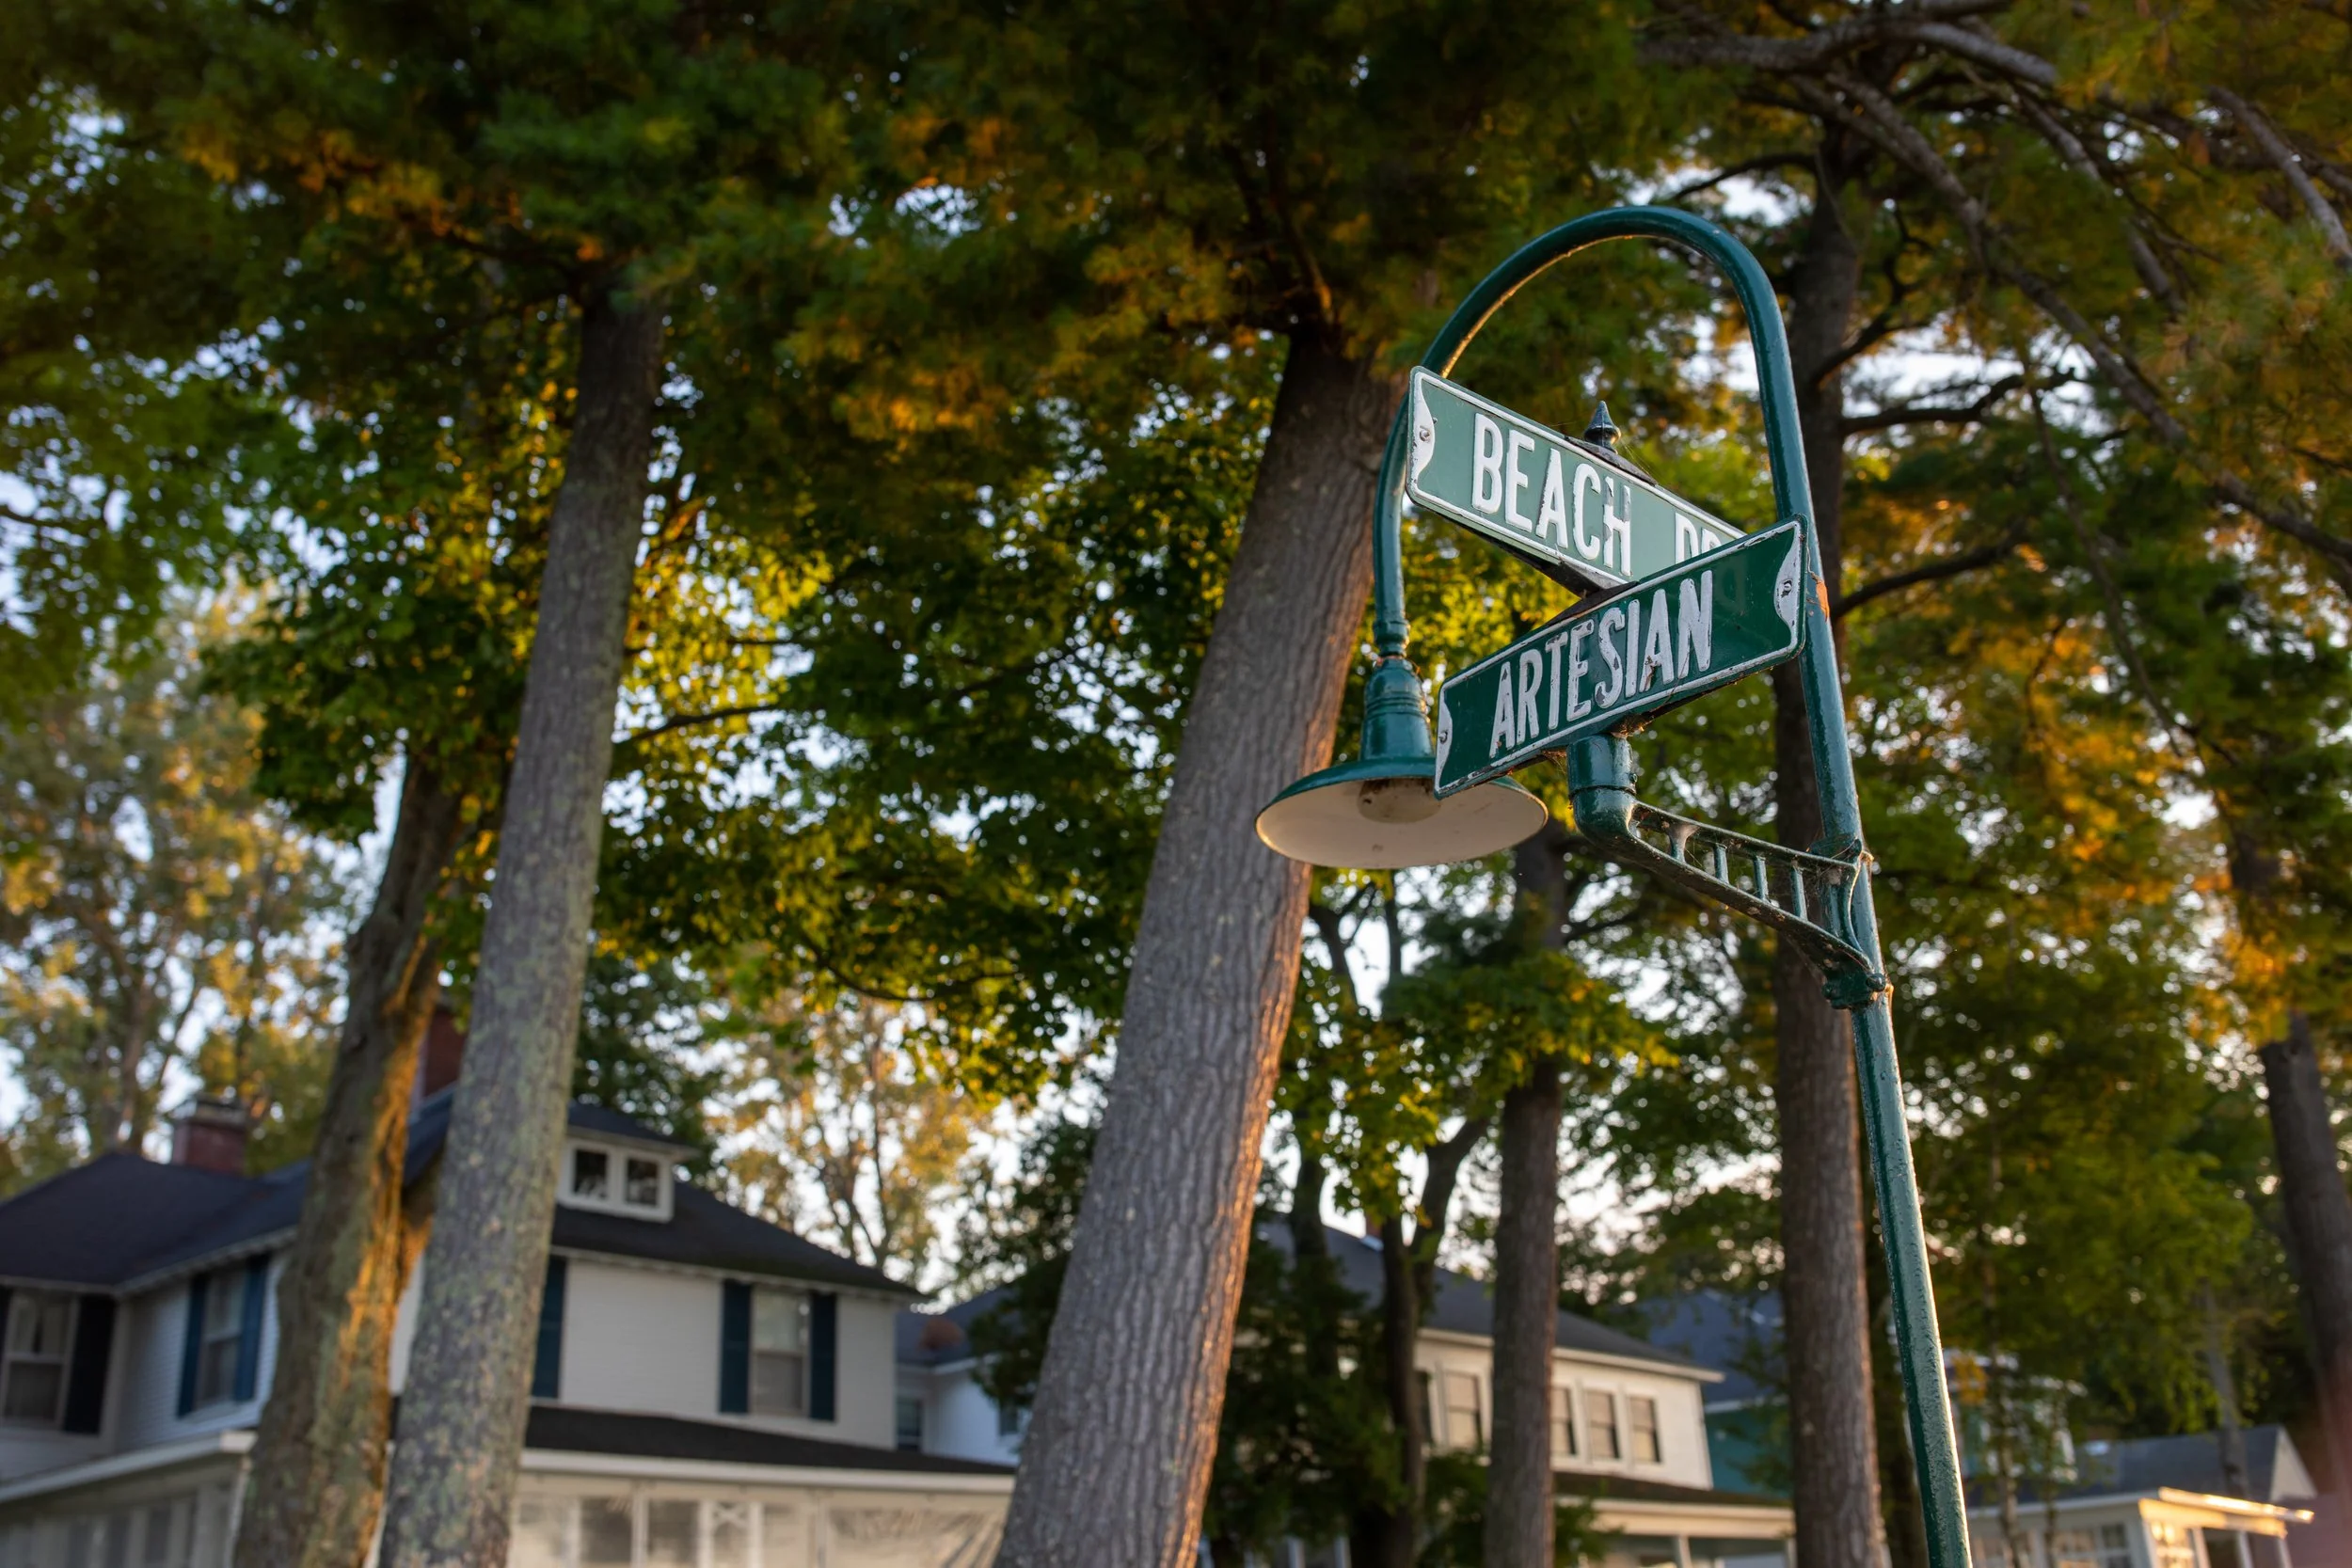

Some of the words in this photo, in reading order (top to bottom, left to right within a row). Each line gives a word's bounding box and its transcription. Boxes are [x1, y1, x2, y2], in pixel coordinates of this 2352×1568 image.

[1471, 412, 1631, 577] BEACH
[1675, 512, 1723, 564] D
[1489, 570, 1712, 758] ARTESIAN
